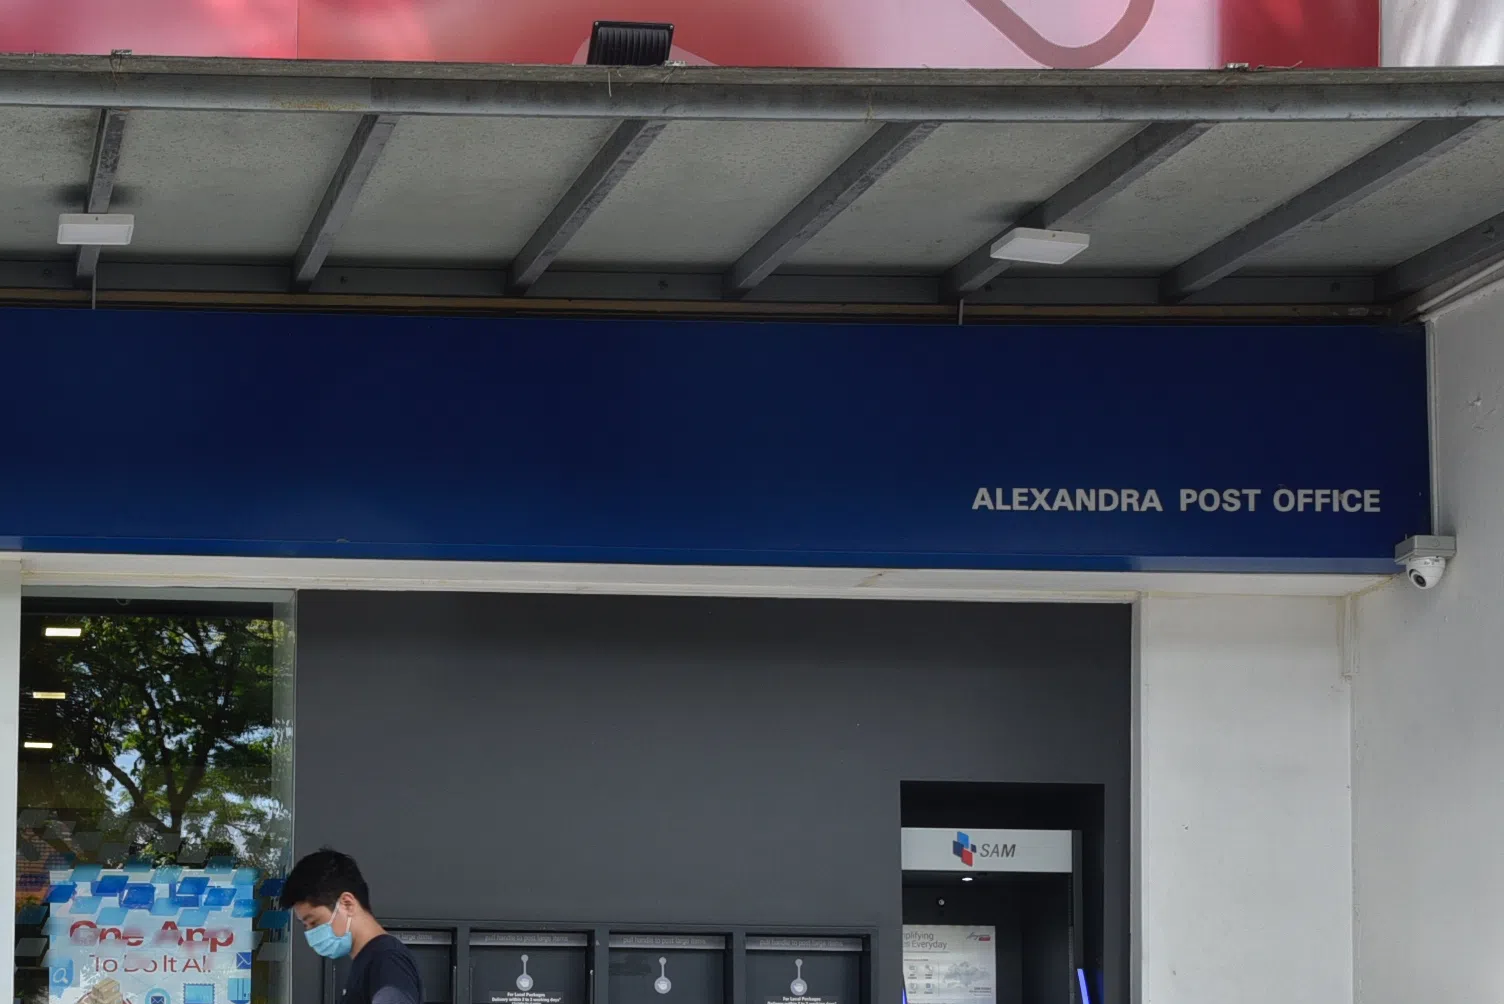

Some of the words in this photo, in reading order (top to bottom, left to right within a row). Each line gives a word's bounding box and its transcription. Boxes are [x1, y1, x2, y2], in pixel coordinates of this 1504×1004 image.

[971, 487, 1163, 511] ALEXANDRA
[1180, 488, 1261, 512] POST
[1273, 488, 1381, 513] OFFICE
[980, 844, 1016, 858] SAM
